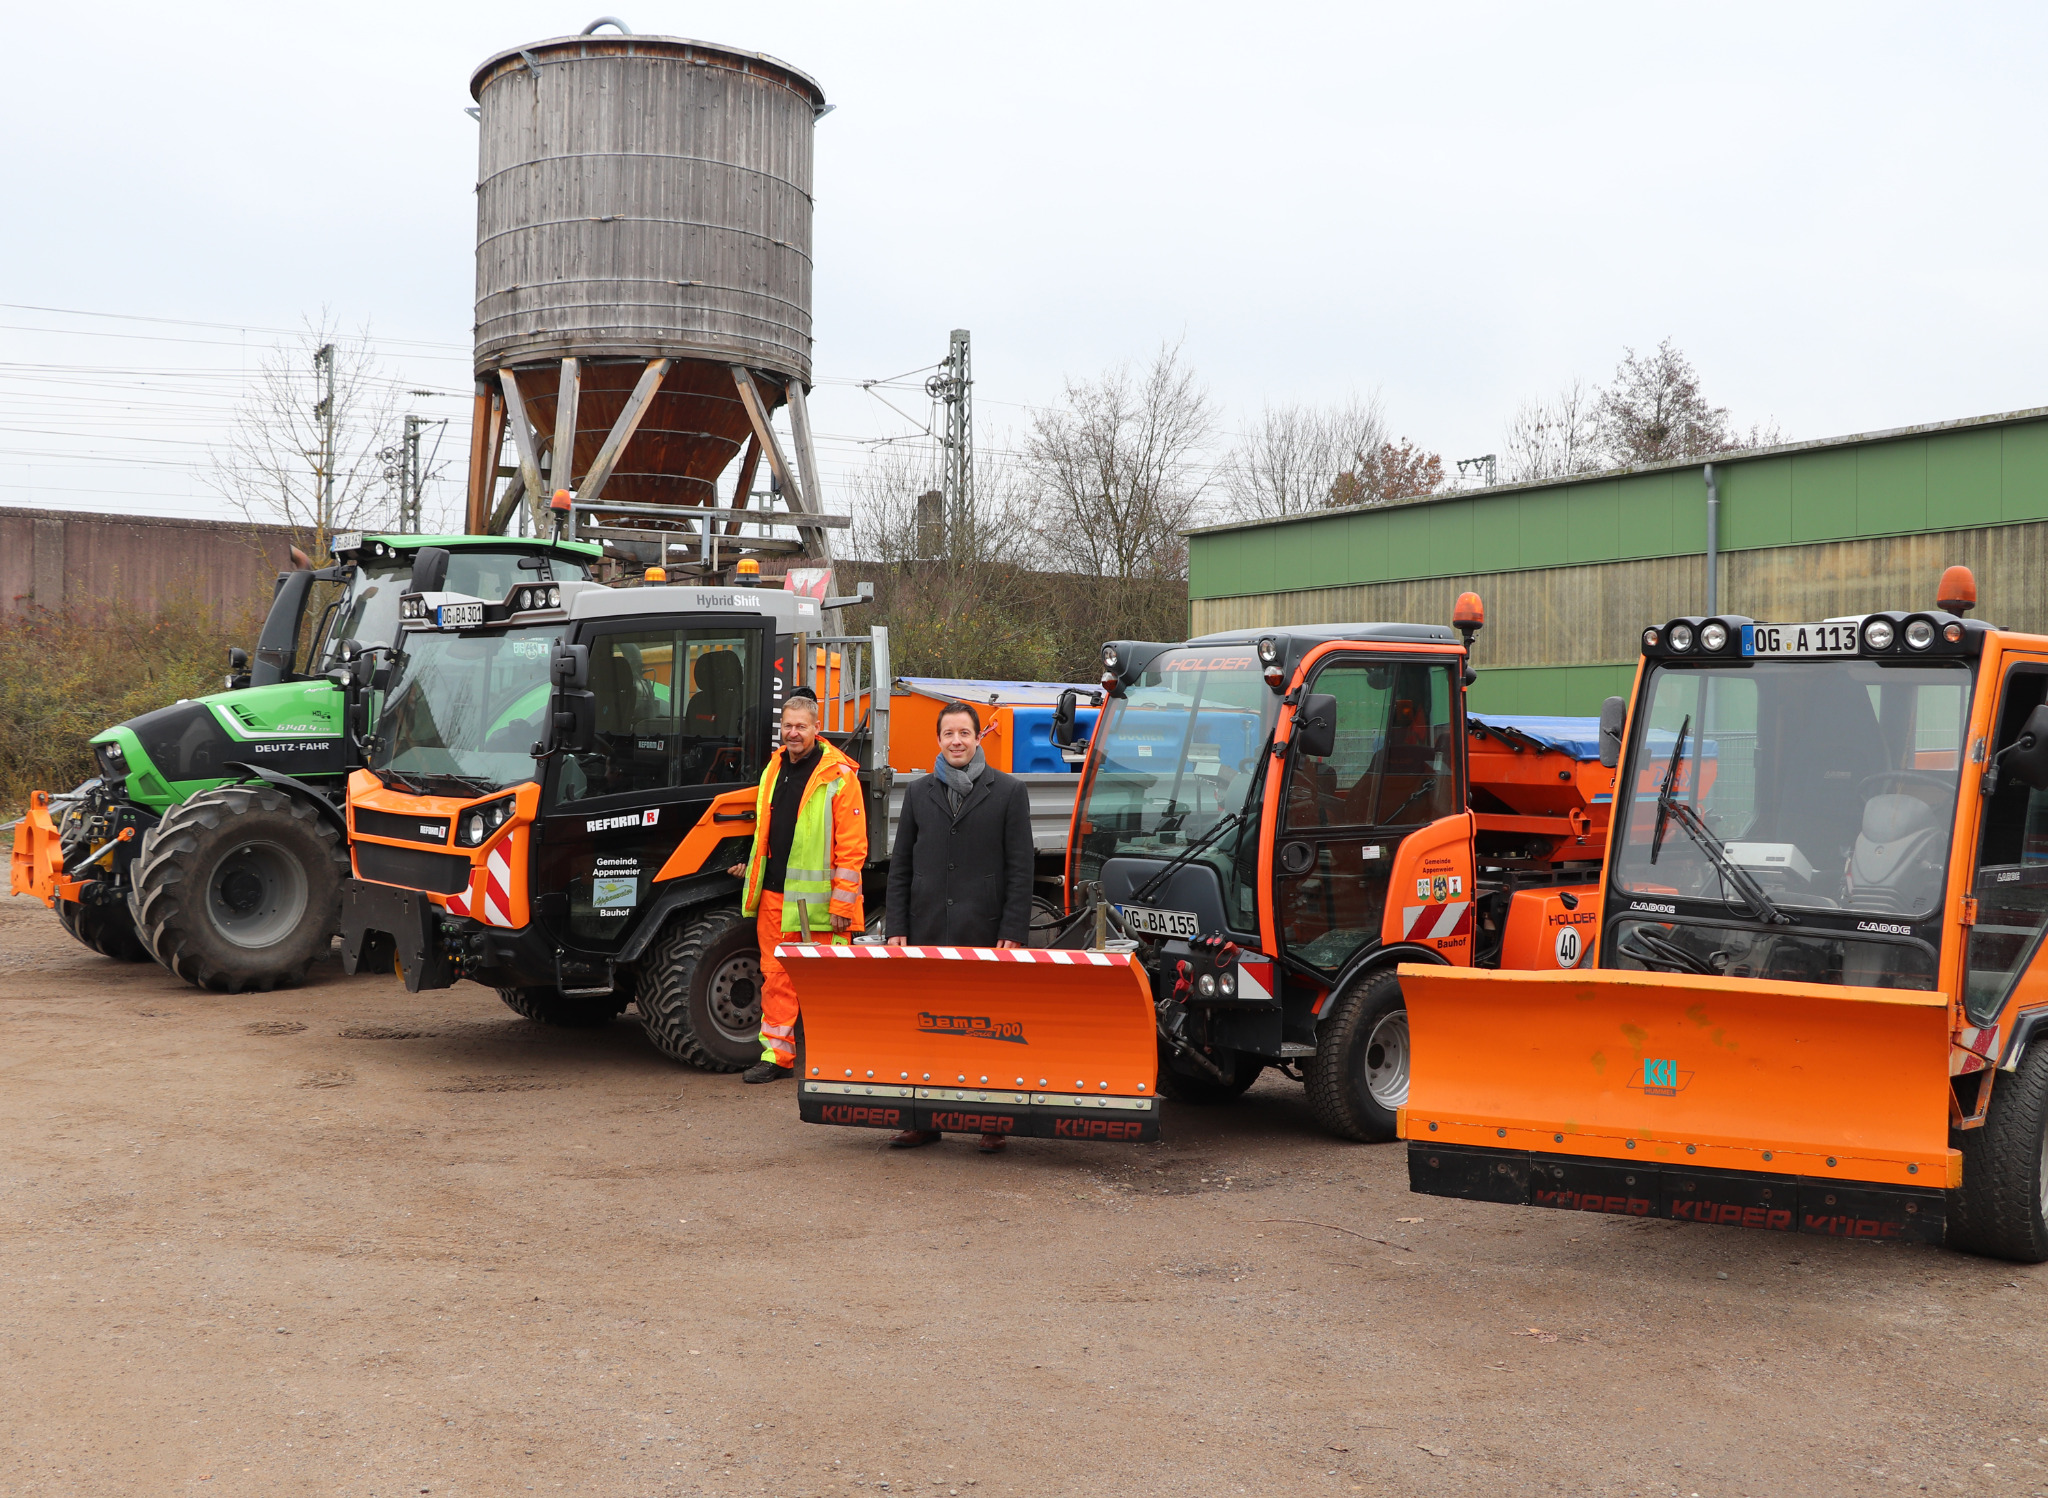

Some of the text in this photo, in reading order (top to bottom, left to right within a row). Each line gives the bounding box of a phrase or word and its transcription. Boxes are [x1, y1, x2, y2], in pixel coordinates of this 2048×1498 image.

[697, 594, 760, 608] HybridShift
[442, 606, 482, 624] OG BA 301
[1755, 626, 1856, 652] OG A 113
[1165, 657, 1253, 671] HOLDER
[255, 742, 330, 753] DEUTZ-FAHR
[586, 814, 641, 833] REFORM
[597, 857, 638, 866] Gemeinde
[1425, 858, 1451, 866] Gemeinde
[592, 868, 641, 878] Appenweier
[1422, 866, 1454, 874] Appenweier
[600, 908, 630, 917] Bauhof
[1630, 901, 1676, 914] LADOG
[1148, 912, 1168, 932] BA
[1169, 915, 1196, 935] 155
[1548, 912, 1597, 926] HOLDER
[1856, 921, 1911, 936] LADOG
[1437, 937, 1467, 949] Bauhof
[1560, 934, 1576, 960] 40
[993, 1022, 1023, 1038] 700
[821, 1104, 900, 1126] KÜPER
[931, 1112, 1014, 1133] KÜPER
[1055, 1118, 1143, 1139] KÜPER
[1671, 1199, 1791, 1231] KÜPER
